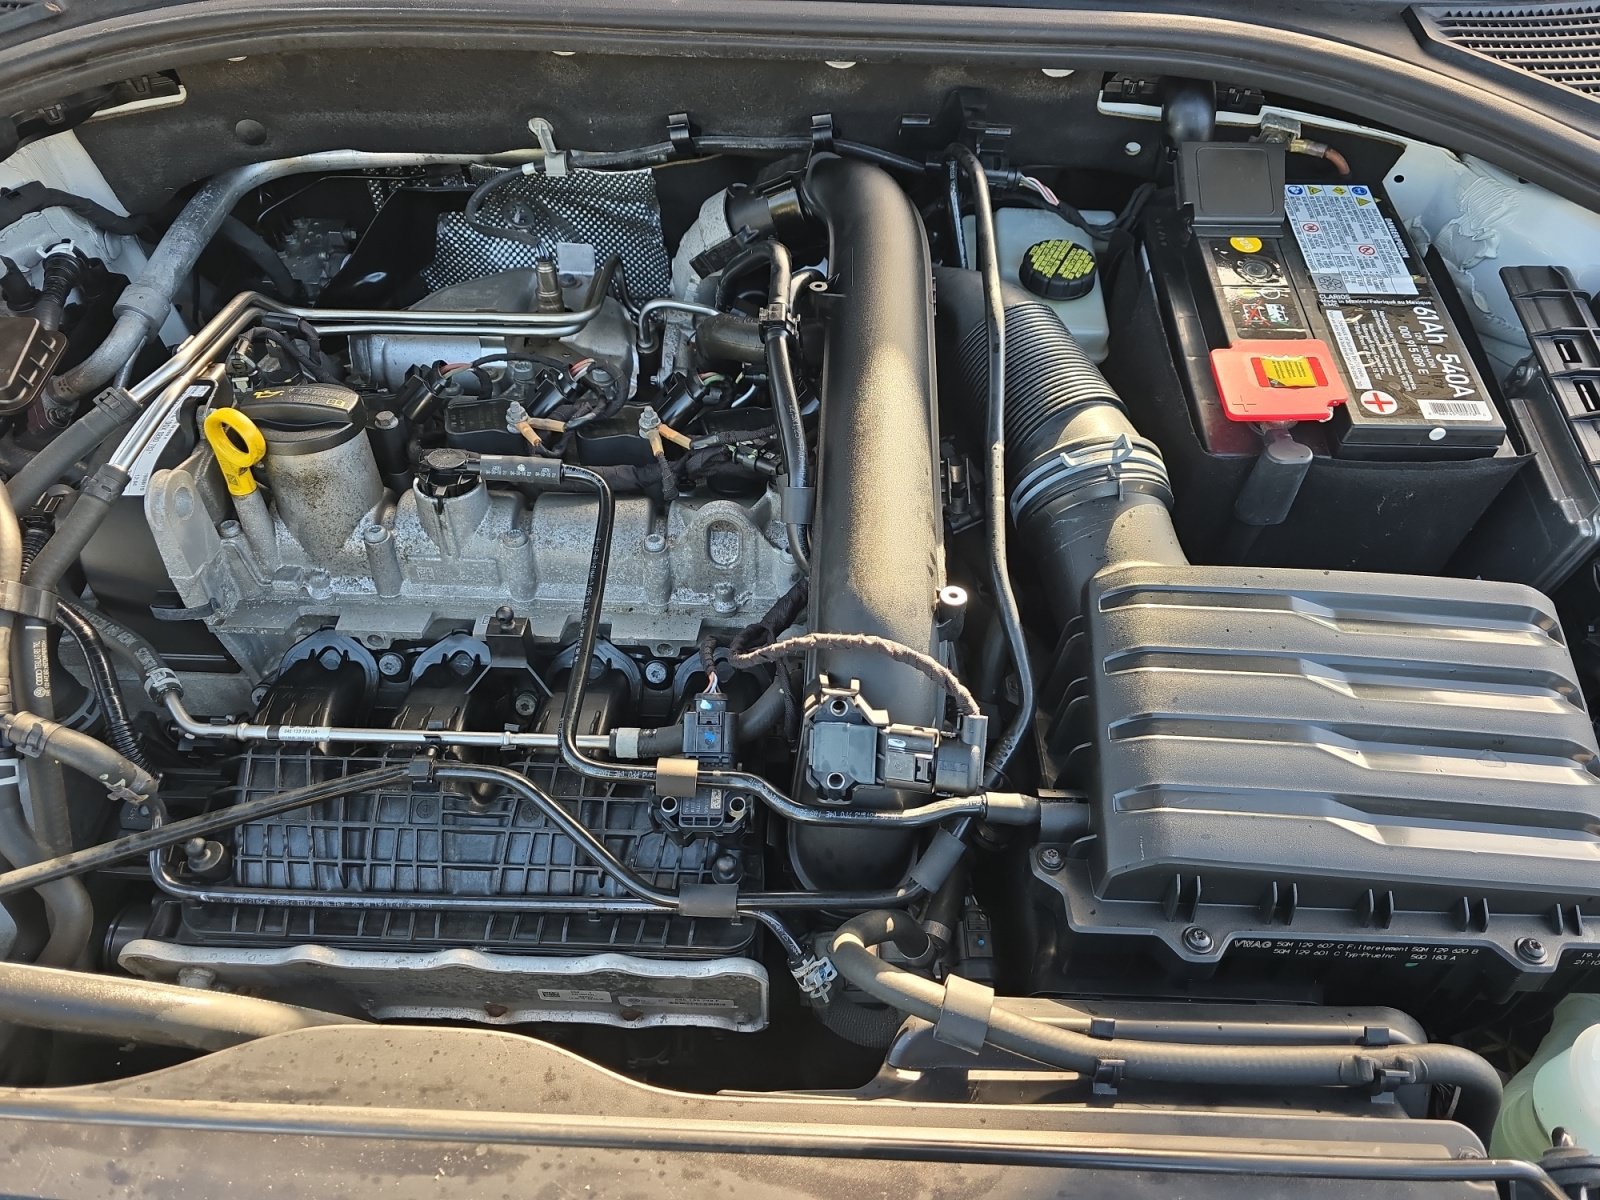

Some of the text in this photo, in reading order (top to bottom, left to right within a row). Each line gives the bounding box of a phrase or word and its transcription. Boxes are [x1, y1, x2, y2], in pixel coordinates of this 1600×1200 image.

[1384, 218, 1410, 258] DANGER/POISON
[1398, 326, 1412, 338] 000
[1404, 340, 1419, 352] 915
[1414, 332, 1424, 341] 12V
[1421, 345, 1431, 357] 330A
[1413, 306, 1448, 344] 61Ah
[1436, 353, 1475, 398] 540A
[1411, 354, 1425, 366] 089
[1234, 940, 1272, 949] VWAG
[1346, 944, 1408, 952] Filterelement
